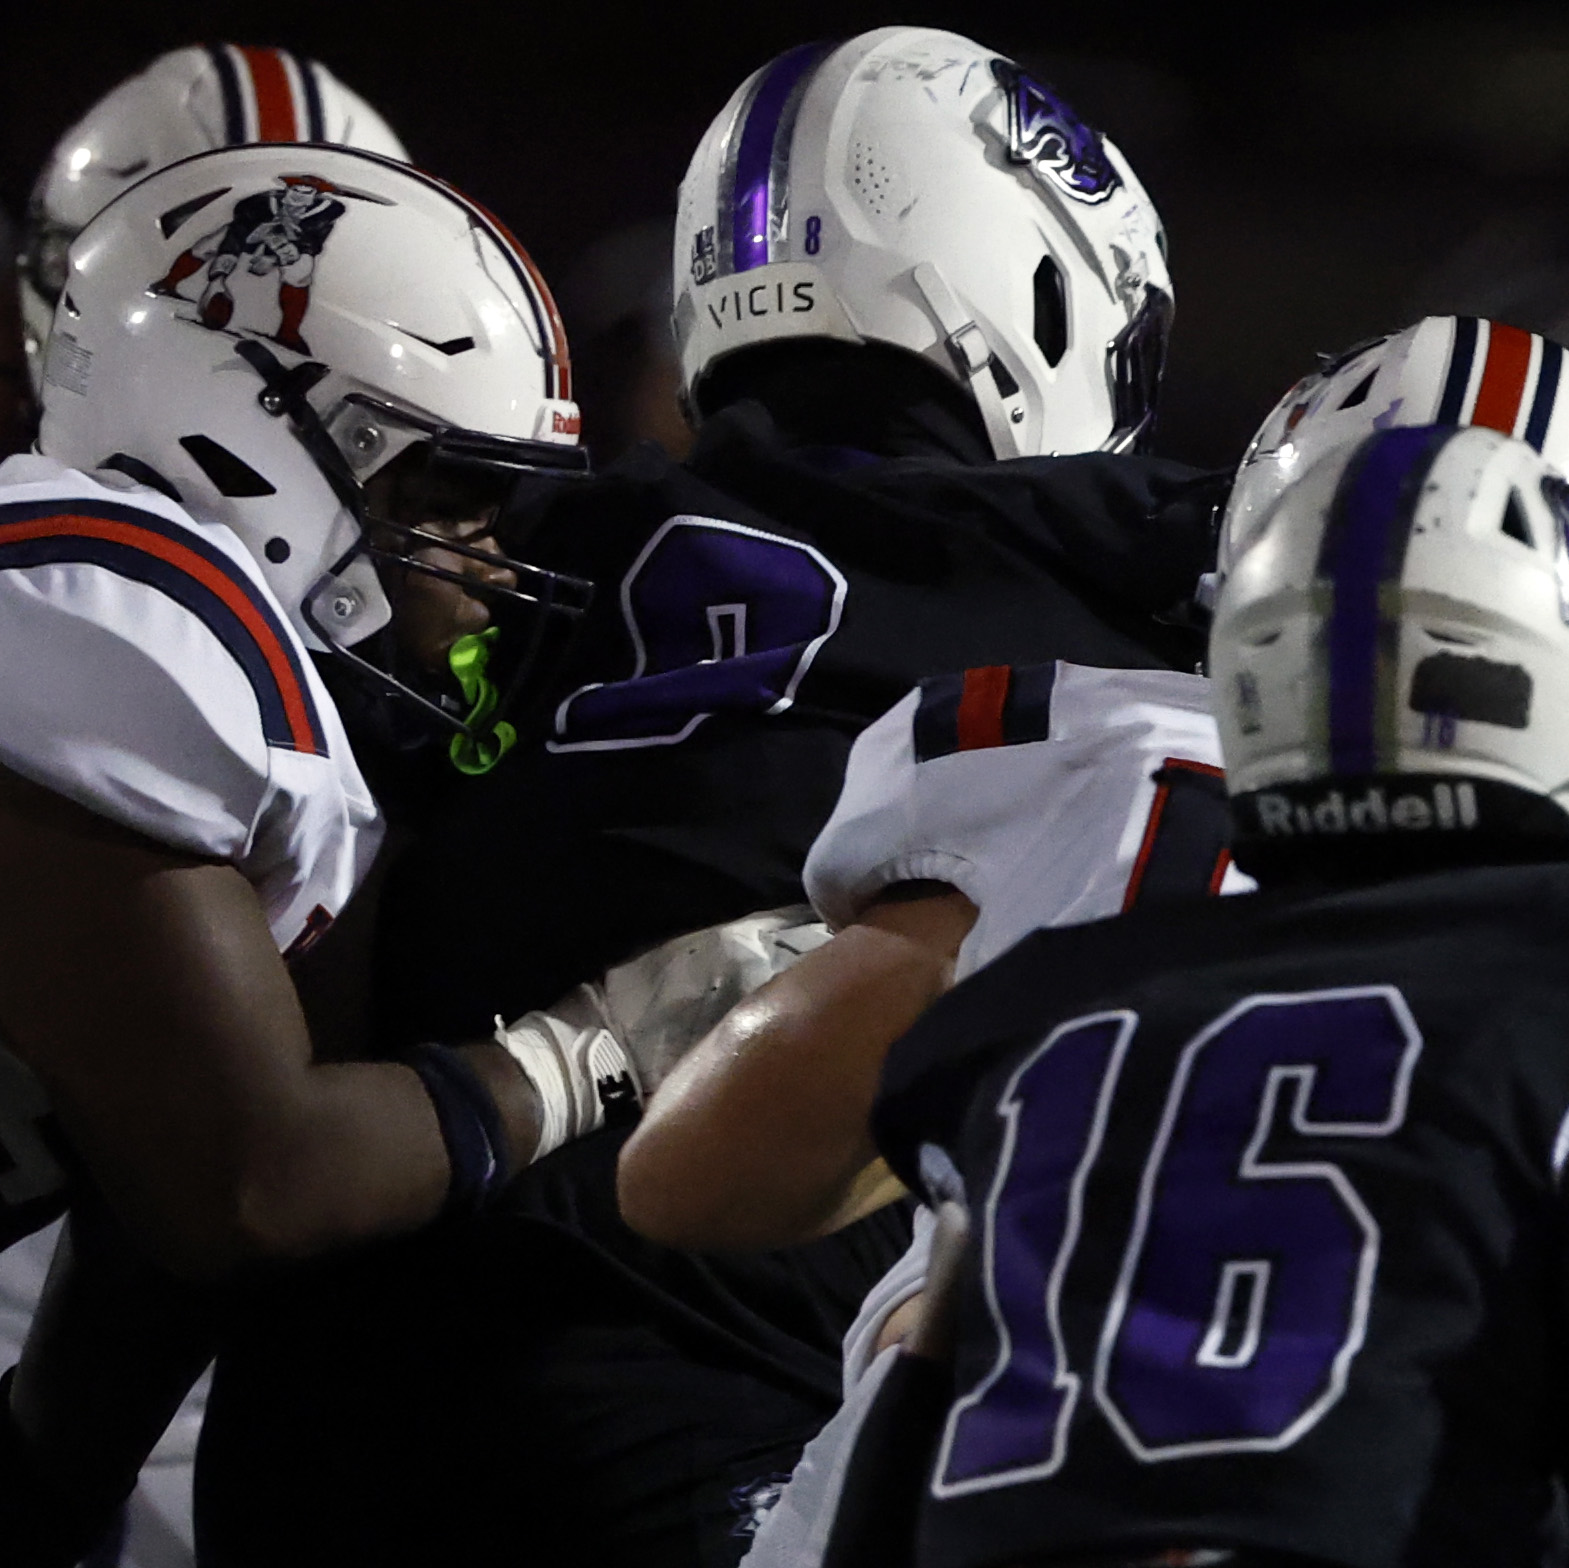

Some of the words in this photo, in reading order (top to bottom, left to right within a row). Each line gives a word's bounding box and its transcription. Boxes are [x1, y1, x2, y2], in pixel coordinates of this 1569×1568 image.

[804, 215, 822, 255] 8
[707, 282, 815, 330] VICIS
[1256, 781, 1478, 837] Riddell
[931, 984, 1424, 1499] 16
